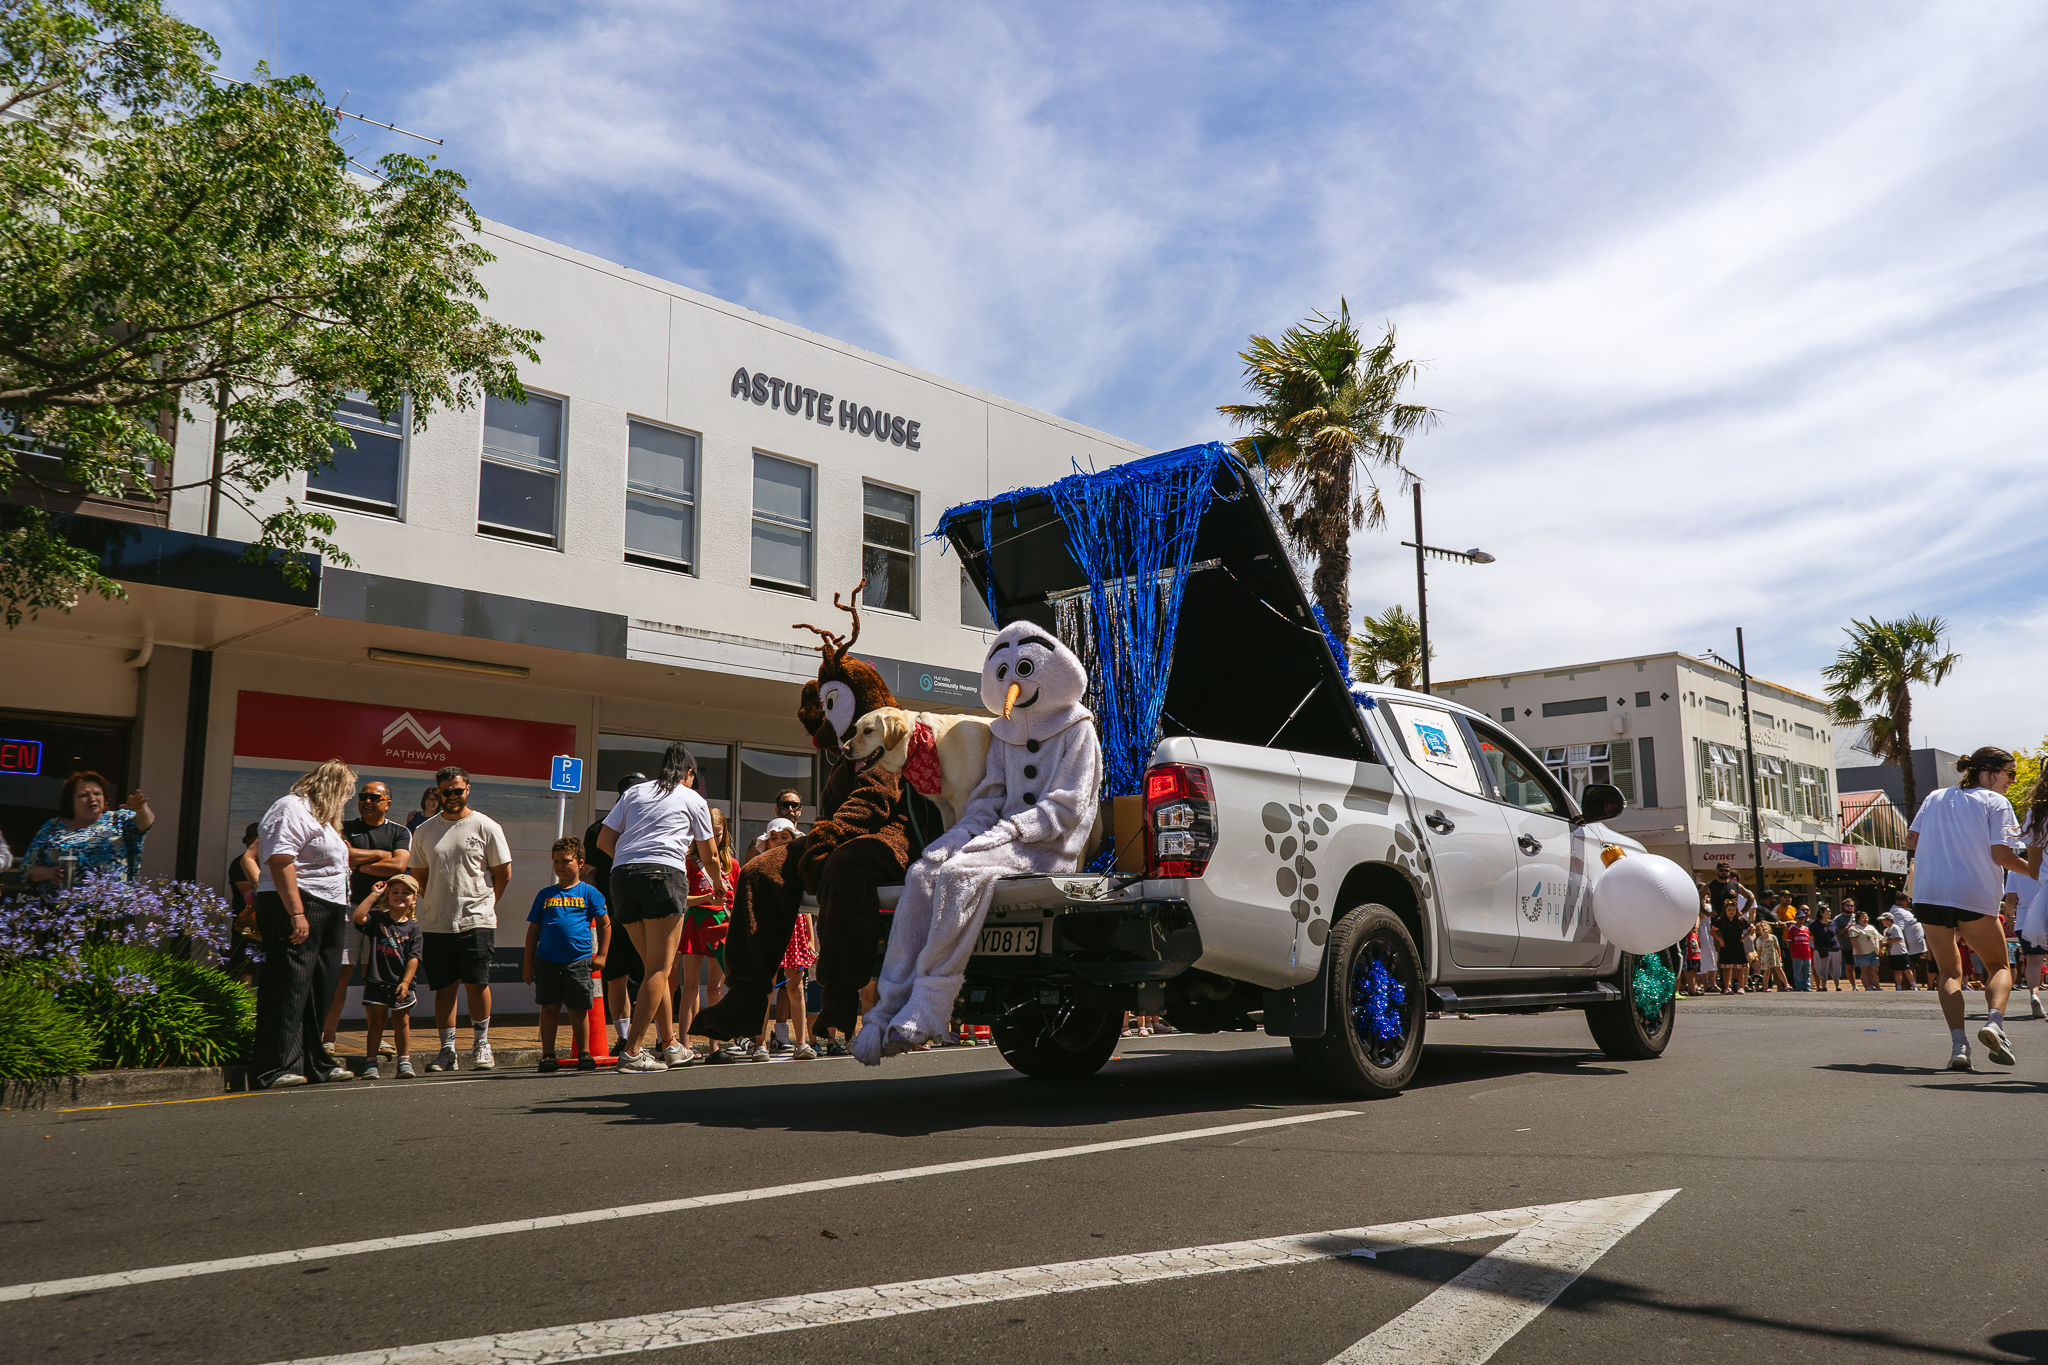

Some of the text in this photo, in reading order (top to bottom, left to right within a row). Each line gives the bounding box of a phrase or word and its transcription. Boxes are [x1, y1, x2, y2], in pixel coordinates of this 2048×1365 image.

[731, 367, 921, 450] ASTUTE HOUSE
[934, 680, 959, 690] Community
[959, 684, 978, 693] Housing
[385, 748, 446, 761] PATHWAYS
[562, 760, 573, 771] P
[562, 773, 571, 783] 15
[1703, 852, 1736, 861] Corner
[1831, 849, 1854, 865] SWEET
[1772, 870, 1796, 883] Bakery
[1547, 882, 1572, 898] QUEEN
[973, 929, 1037, 953] YD813
